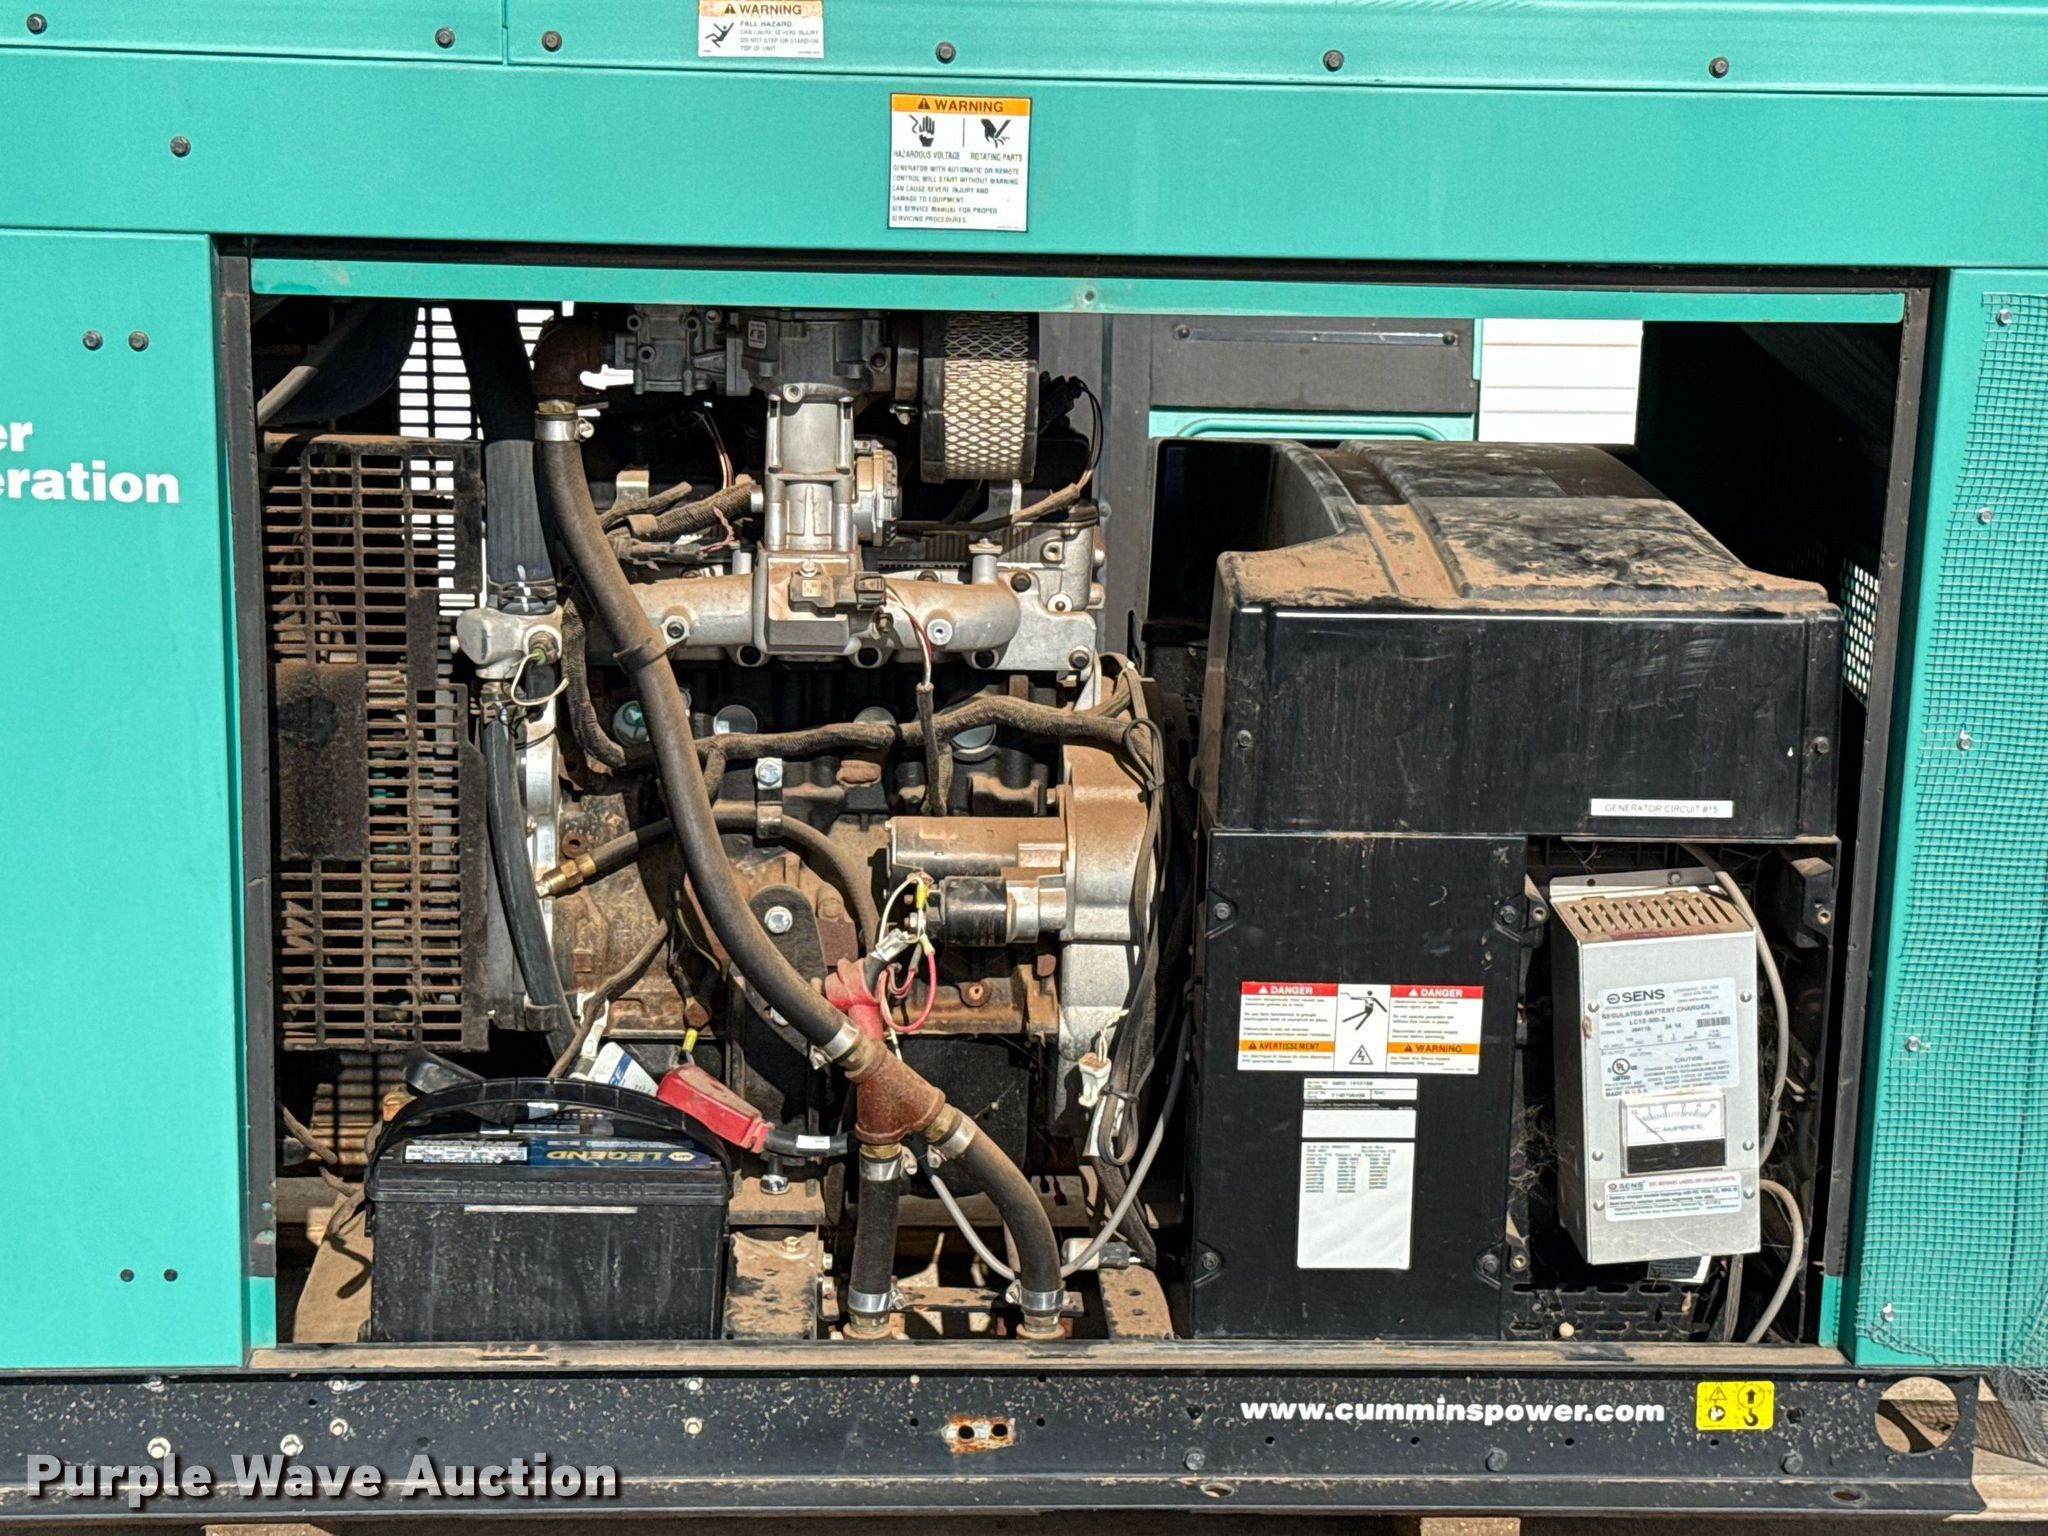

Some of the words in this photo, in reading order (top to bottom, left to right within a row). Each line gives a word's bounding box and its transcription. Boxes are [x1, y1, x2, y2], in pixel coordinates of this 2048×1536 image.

[739, 4, 802, 15] WARNING
[934, 100, 1004, 113] WARNING
[893, 150, 932, 160] HAZARDOUS
[933, 151, 960, 160] VOLTAGE
[970, 152, 1001, 161] ROTATING
[1002, 153, 1022, 162] PARTS
[893, 164, 928, 172] GENERATOR
[948, 166, 981, 174] AUTOMATIC
[892, 184, 904, 192] CAN
[952, 186, 974, 194] INJURY
[0, 422, 33, 452] r
[0, 460, 179, 504] ration
[1604, 804, 1662, 812] GENERATOR
[1664, 805, 1700, 814] CIRCUIT
[1270, 986, 1312, 995] DANGER
[1420, 988, 1464, 998] DANGER
[1622, 988, 1666, 1003] SENS
[1602, 1010, 1642, 1020] REGULATED
[1644, 1007, 1675, 1016] BATTERY
[1677, 1004, 1710, 1012] CHARGER
[1259, 1042, 1320, 1050] AVERTISSEMENT
[1416, 1045, 1463, 1053] WARNING
[546, 1150, 664, 1161] LEGEND
[1240, 1396, 1665, 1425] www.cumminspower.com
